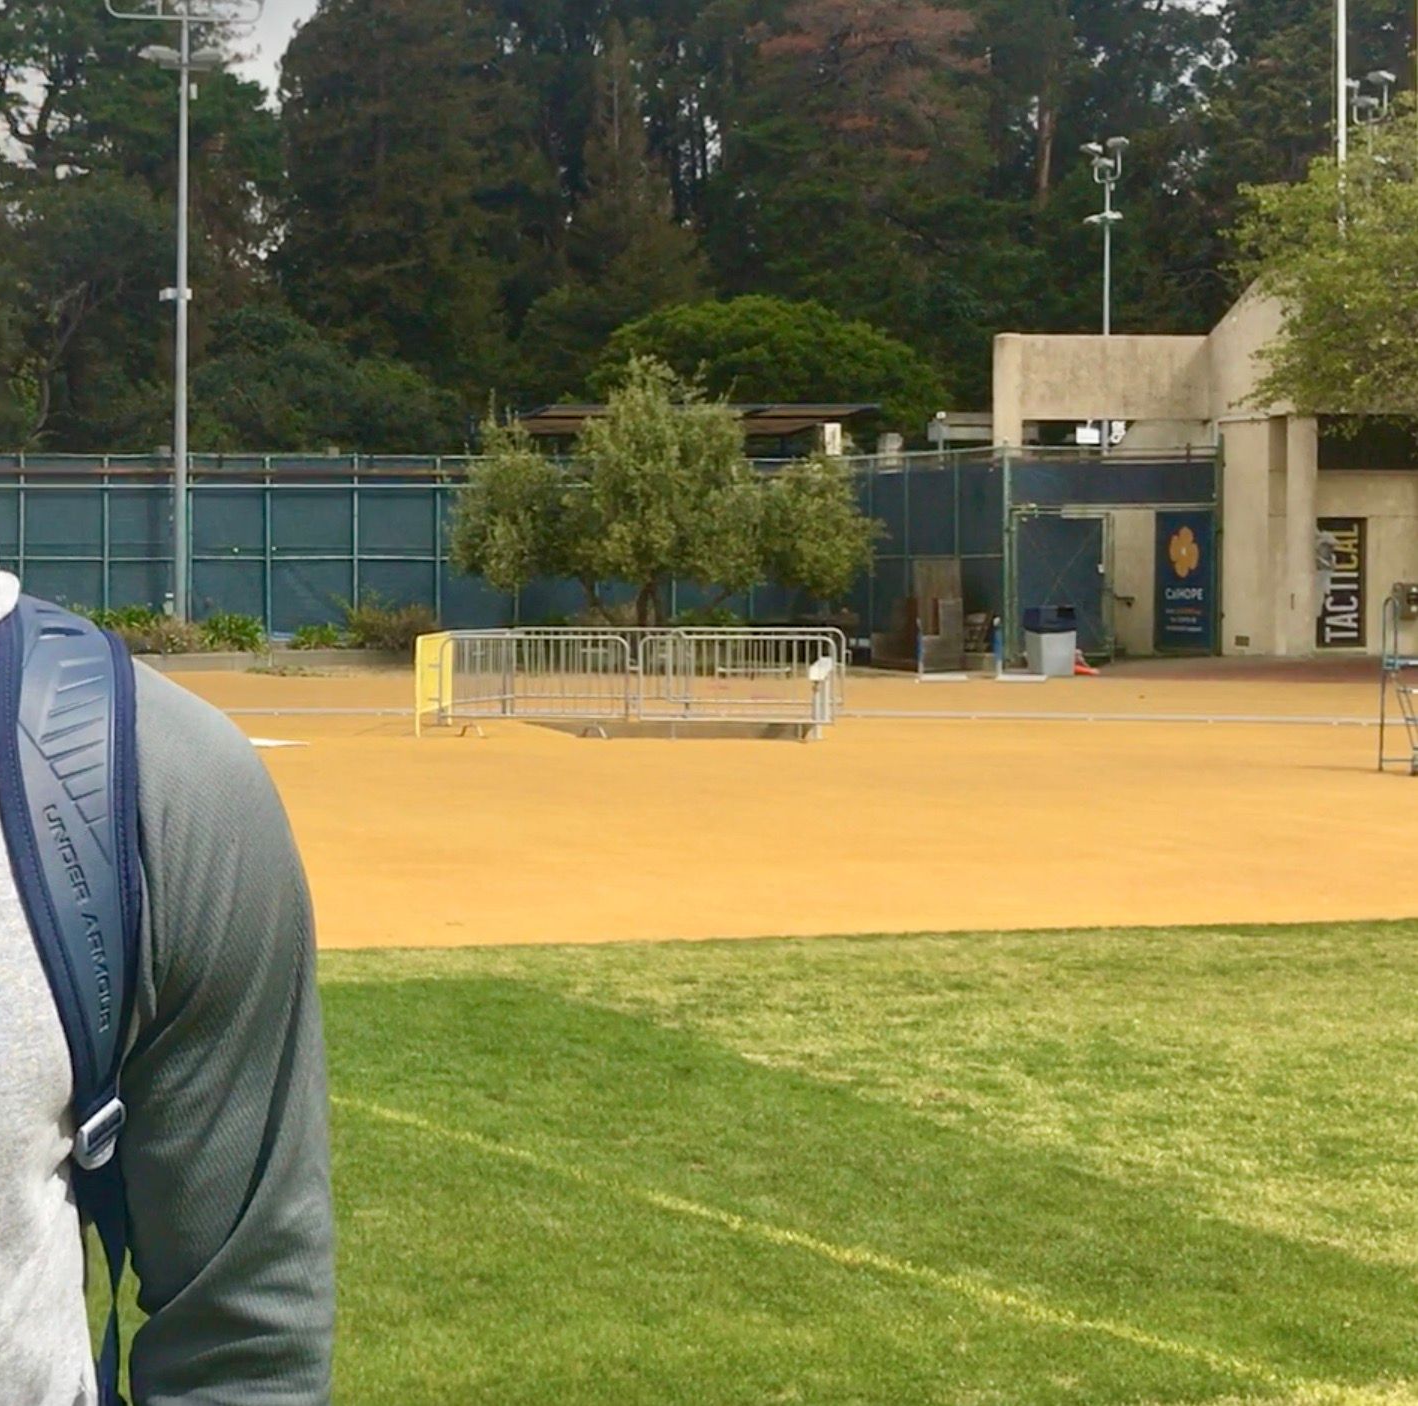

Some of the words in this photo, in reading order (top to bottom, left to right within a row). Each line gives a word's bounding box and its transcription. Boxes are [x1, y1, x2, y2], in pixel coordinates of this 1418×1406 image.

[1324, 523, 1359, 643] TACTICAL
[43, 803, 92, 906] UNDER
[82, 912, 111, 1034] ARMOUR
